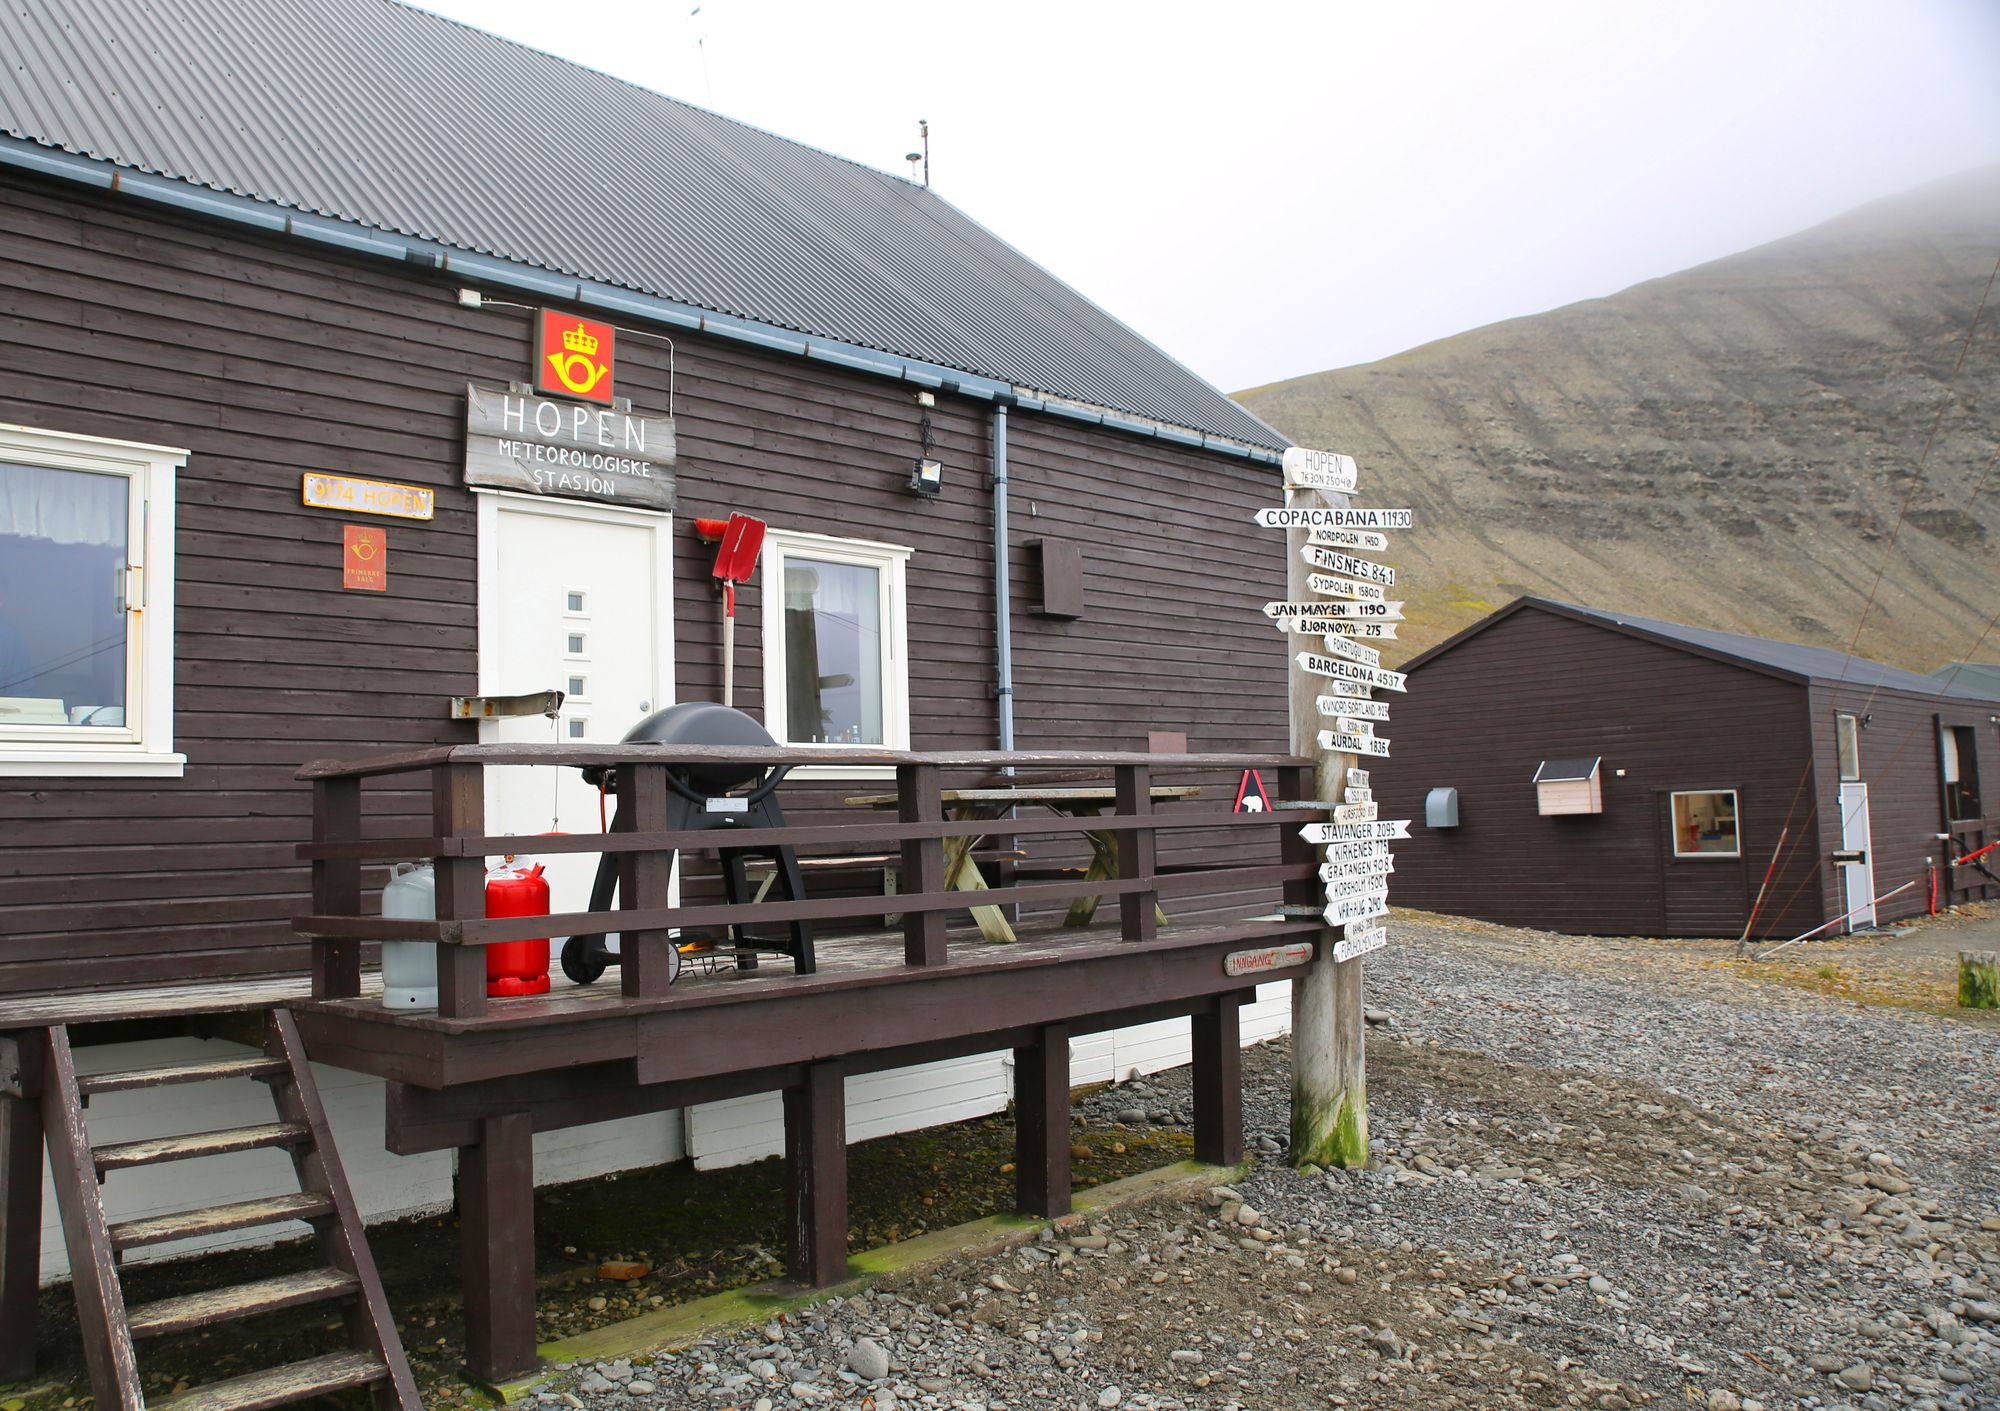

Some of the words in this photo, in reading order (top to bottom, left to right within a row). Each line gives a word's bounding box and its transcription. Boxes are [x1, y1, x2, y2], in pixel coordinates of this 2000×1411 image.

[503, 395, 645, 452] HOPEN
[499, 439, 651, 477] METEOROLOGISKE
[1305, 450, 1343, 474] HOPEN
[533, 469, 615, 496] STASJON
[314, 482, 353, 503] 9174
[364, 489, 425, 512] HOPEN
[1266, 511, 1378, 526] COPACABANA
[1382, 511, 1411, 526] 11930
[1317, 530, 1359, 544] NORDPOLEN
[1315, 549, 1368, 577] FINSNES
[1372, 565, 1393, 585] 841
[1314, 577, 1354, 594] SYDPOLEN
[1272, 605, 1298, 616] JAN
[1359, 605, 1387, 616] 1190
[1301, 620, 1357, 635] BJØRNØYA
[1366, 625, 1381, 636] 275
[1308, 657, 1374, 682] BARCELONA
[1377, 673, 1400, 688] 4537
[1331, 734, 1362, 750] AURDAL
[1370, 741, 1387, 754] 1836
[1321, 824, 1373, 840] STAVANGER
[1376, 822, 1396, 838] 2095
[1334, 841, 1373, 860] KIRKENES
[1375, 839, 1388, 855] 775
[1327, 861, 1371, 879] GRATANGEN
[1373, 856, 1390, 873] 908
[1334, 878, 1366, 898] KORSHOLM
[1232, 953, 1272, 973] INNGANG
